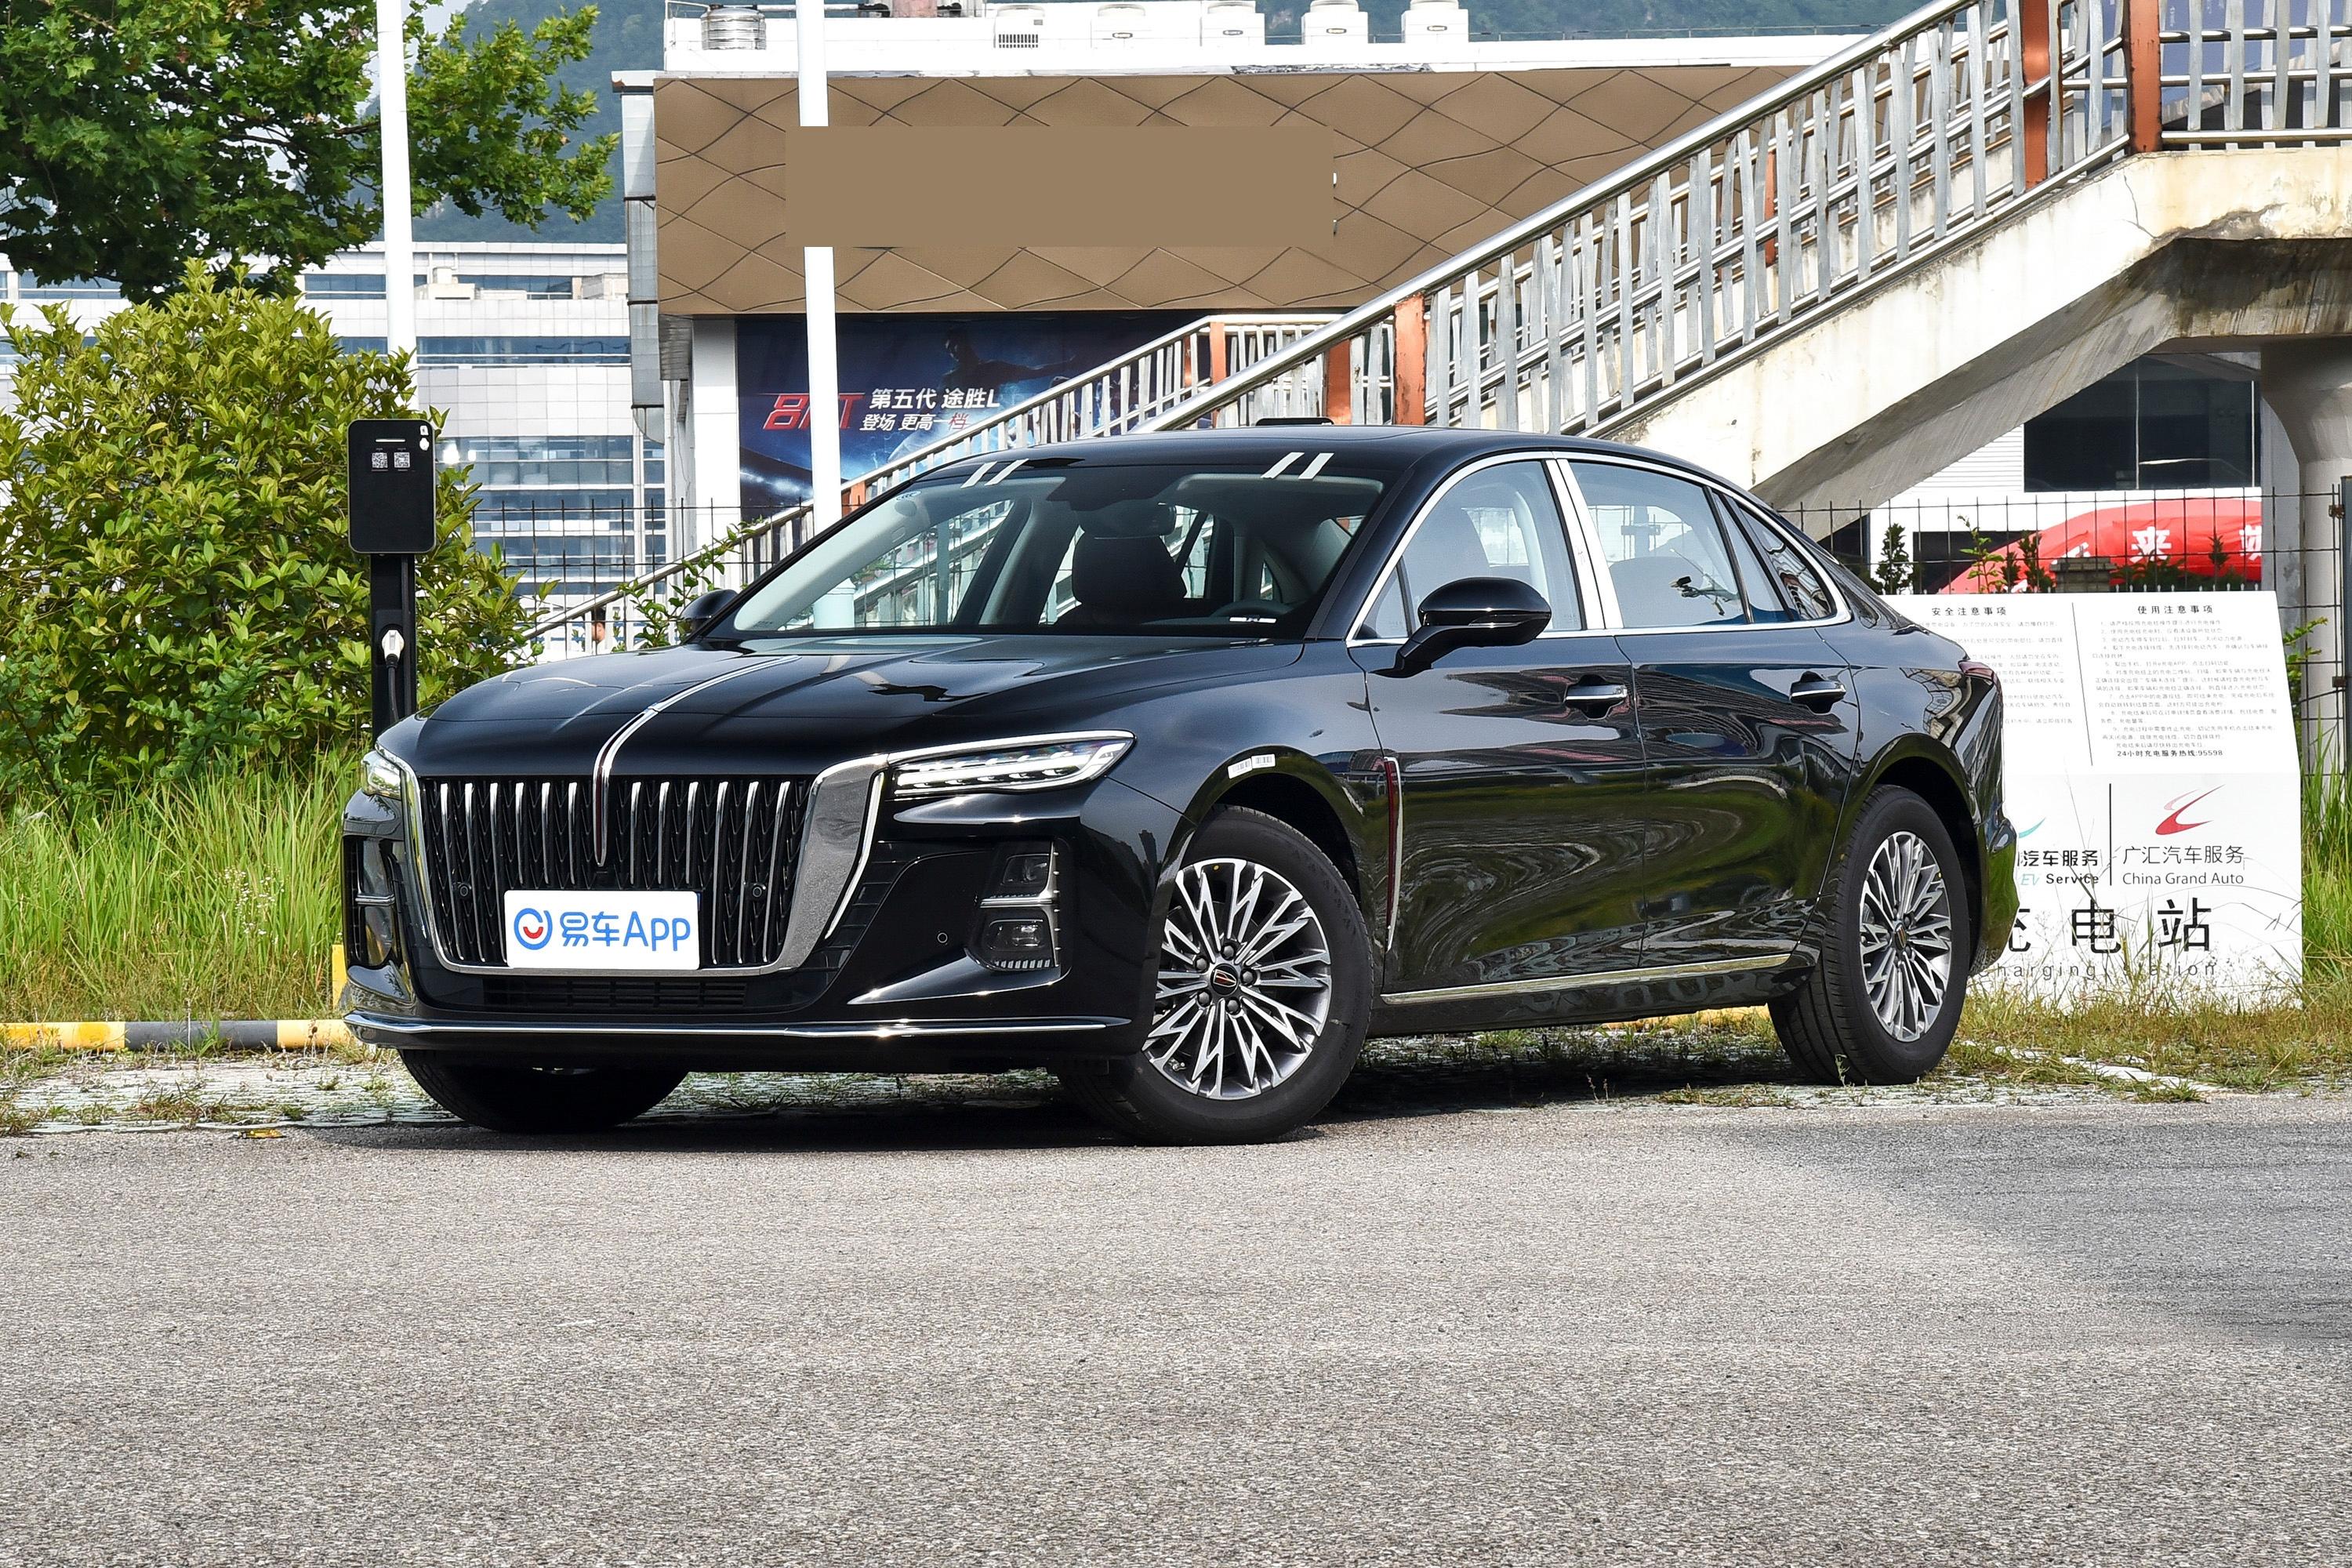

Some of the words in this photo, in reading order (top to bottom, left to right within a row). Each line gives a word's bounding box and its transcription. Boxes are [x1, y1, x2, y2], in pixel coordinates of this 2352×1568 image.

[869, 387, 938, 410] 第五代
[940, 387, 1001, 410] 途胜L
[762, 393, 866, 430] 8T
[859, 413, 897, 431] 登场
[898, 412, 971, 431] 更高一档
[1931, 607, 2008, 616] 安全注意事项
[2137, 604, 2214, 615] 使用注意事项
[2017, 850, 2098, 866] 汽车服务
[2123, 845, 2245, 864] 广汇汽车服务
[2045, 873, 2099, 884] Service
[2122, 873, 2161, 885] China
[2165, 872, 2206, 884] Grand
[2211, 872, 2245, 884] Auto
[560, 911, 691, 951] 易车App
